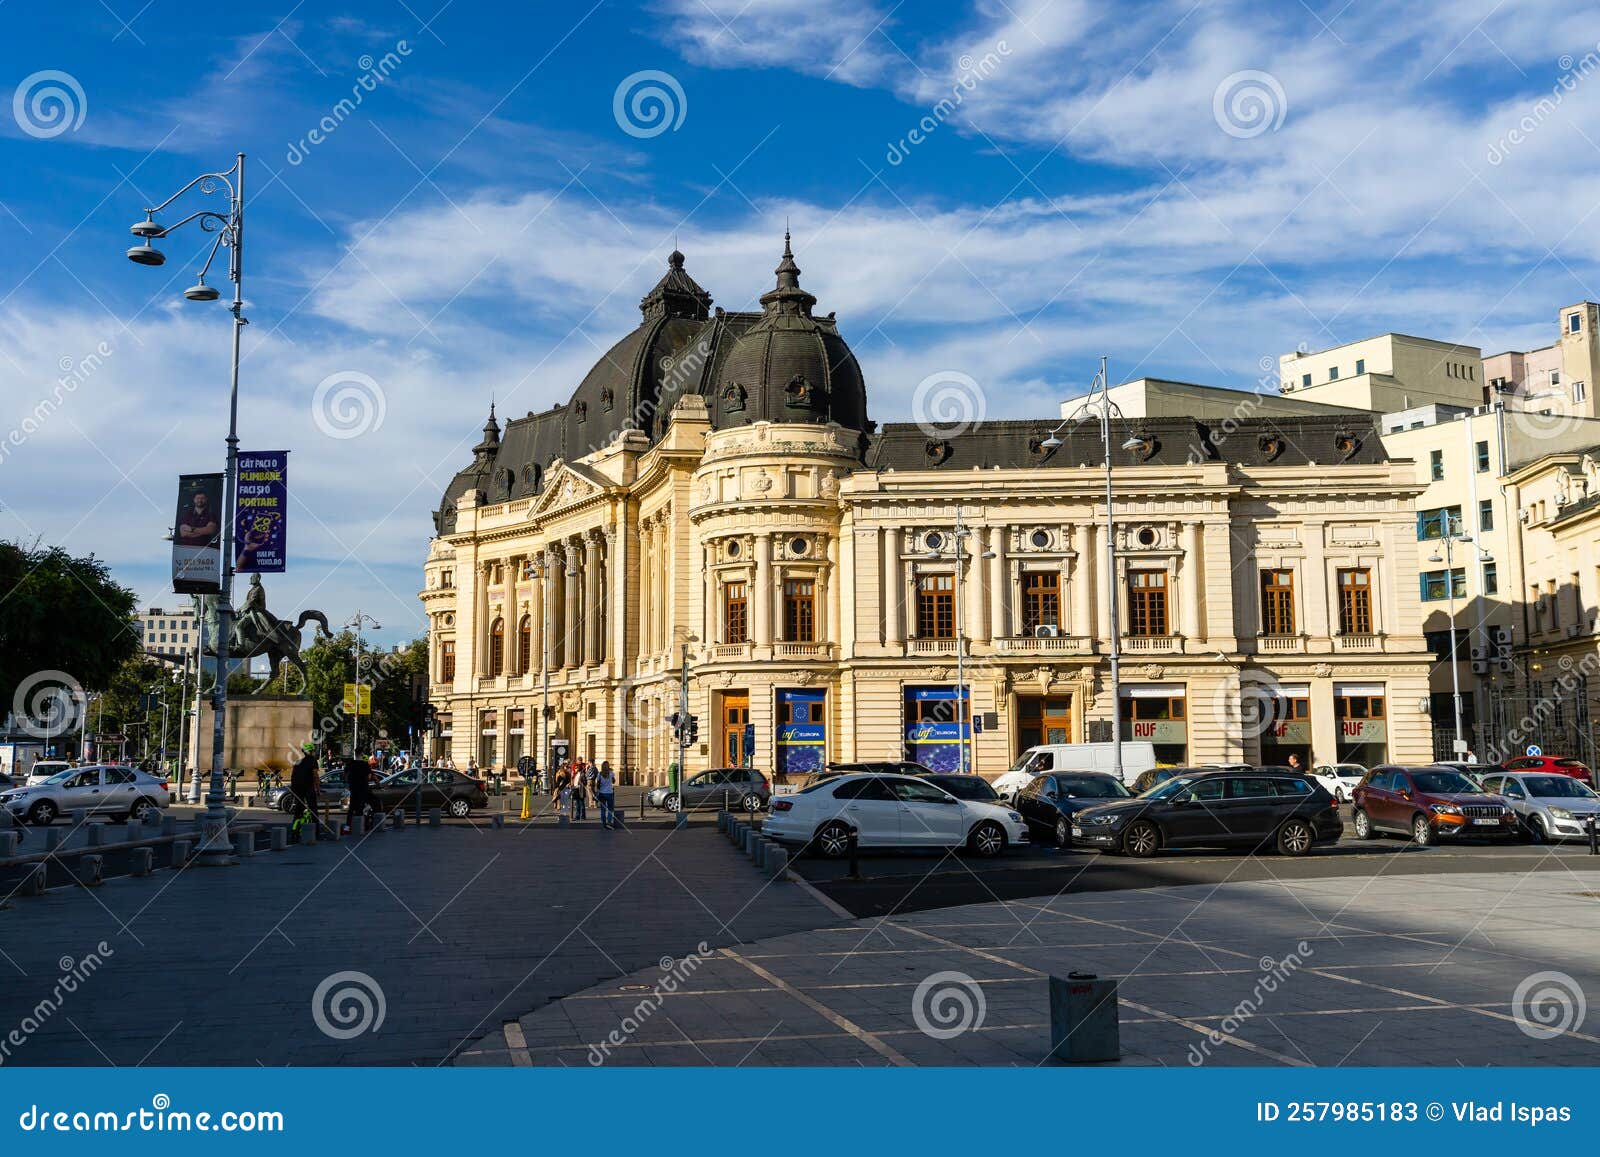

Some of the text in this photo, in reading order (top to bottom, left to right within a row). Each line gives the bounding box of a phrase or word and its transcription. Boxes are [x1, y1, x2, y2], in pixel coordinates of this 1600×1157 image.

[239, 497, 278, 507] PORTARE
[1134, 722, 1157, 737] AUF
[1341, 722, 1363, 736] AUF
